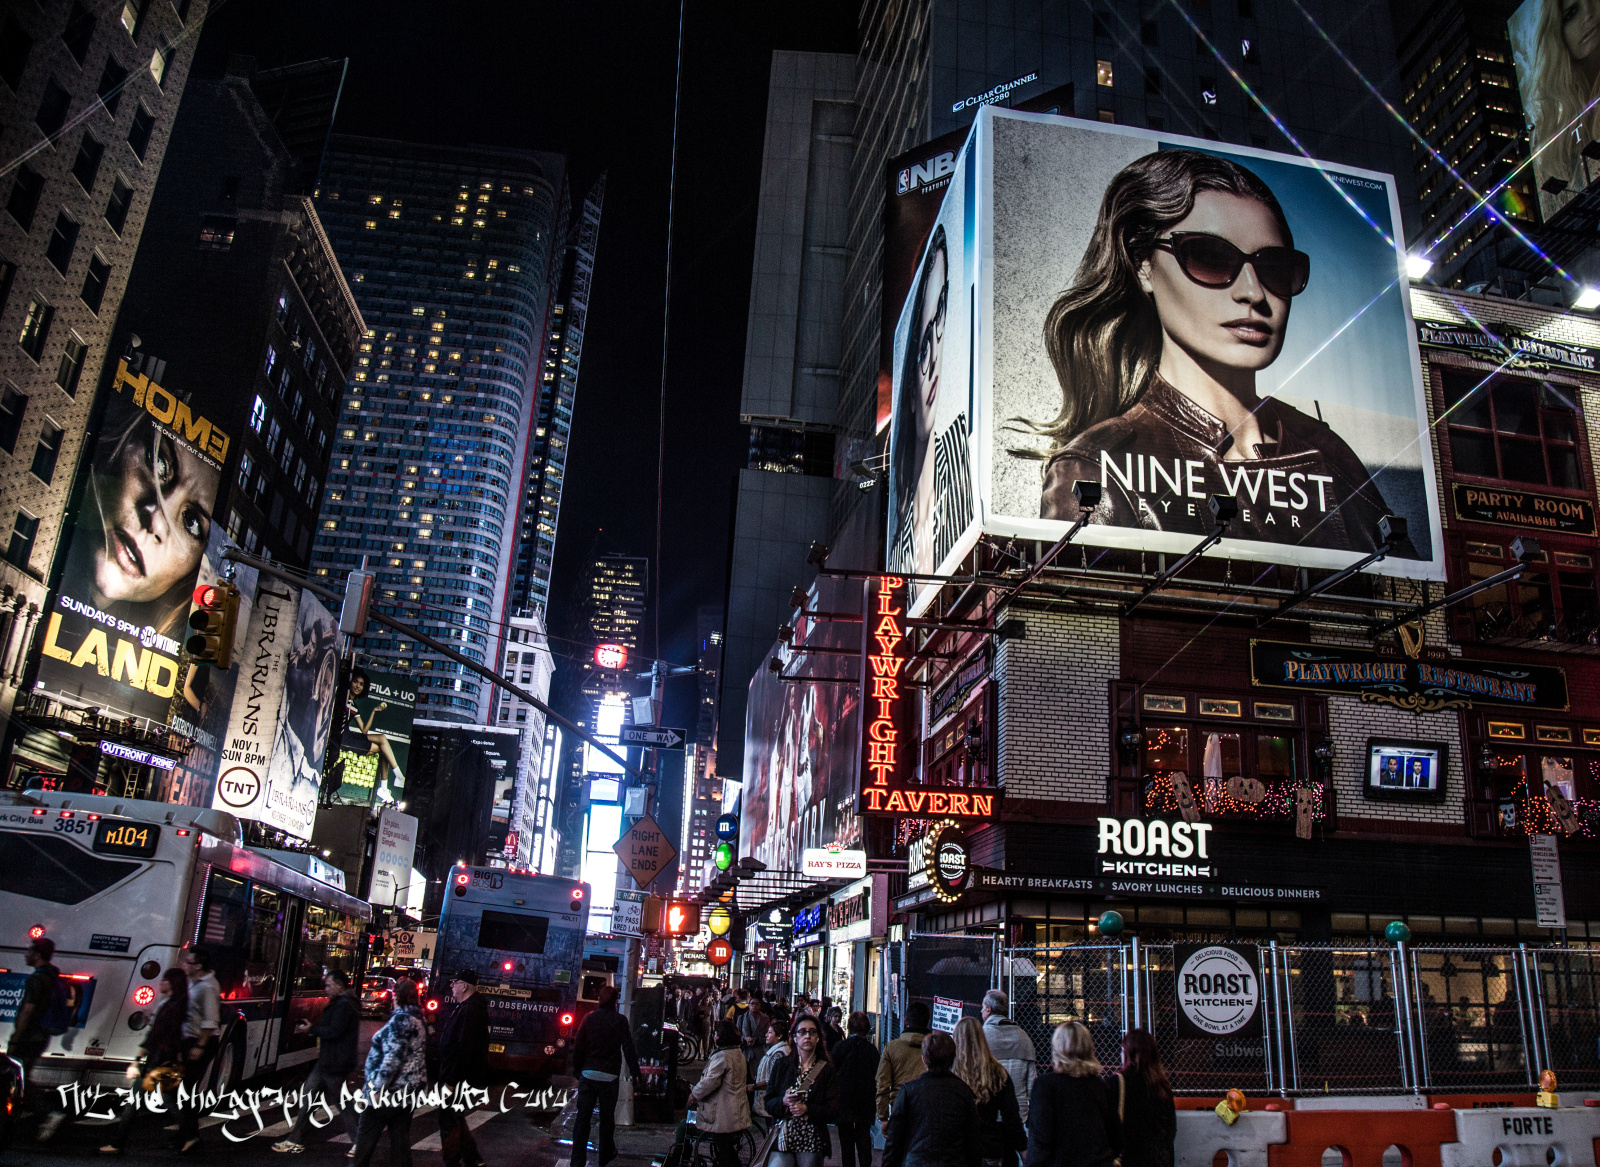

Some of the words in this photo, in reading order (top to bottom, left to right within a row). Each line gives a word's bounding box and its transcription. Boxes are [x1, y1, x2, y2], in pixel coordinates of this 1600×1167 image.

[1327, 174, 1383, 191] NINEWEST.COM
[1511, 336, 1595, 369] RESTAURANT
[152, 421, 162, 432] THE
[162, 428, 177, 441] ONLY
[176, 438, 189, 449] WAY
[187, 445, 198, 456] OUT
[198, 452, 203, 460] IS
[203, 456, 217, 469] BACK
[216, 463, 222, 472] IN
[1101, 450, 1206, 499] NINE
[1218, 464, 1333, 513] WEST
[1138, 499, 1301, 528] EYEEAR
[1466, 490, 1523, 508] PARTY
[1534, 498, 1584, 520] ROOM
[61, 595, 117, 628] SUNDAYS
[117, 619, 140, 638] 9PM
[140, 625, 181, 657] SHOWTIME
[42, 611, 179, 699] LAND
[241, 584, 292, 736] LIBRARIANS
[1379, 644, 1397, 655] Est.
[1427, 650, 1446, 660] 1993
[270, 653, 281, 673] THE
[866, 576, 905, 785] PLAYWRIGHT
[1284, 660, 1408, 684] PLAYWRIGHT
[1418, 662, 1537, 703] RESTAURANT
[369, 682, 391, 697] FILA
[401, 691, 415, 702] UO
[232, 739, 252, 752] NOV
[256, 743, 260, 753] 1
[629, 732, 648, 741] ONE
[657, 734, 676, 743] WAY
[102, 742, 147, 763] OUTFRONT
[150, 756, 175, 770] PRIME
[221, 750, 242, 762] SUN
[244, 753, 266, 766] 8PM
[157, 766, 210, 808] HEART
[225, 781, 255, 795] TNT
[862, 788, 994, 816] TAVERN
[10, 815, 27, 825] City
[28, 816, 44, 825] Bus
[53, 818, 94, 836] 3851
[631, 830, 661, 842] RIGHT
[1097, 818, 1213, 859] ROAST
[631, 844, 659, 857] LANE
[908, 834, 929, 875] ROAS
[631, 859, 657, 871] ENDS
[1116, 861, 1197, 877] KITCHEN
[474, 870, 490, 881] BIG
[471, 879, 490, 890] BUS
[982, 875, 1025, 887] HEARTY
[1028, 877, 1093, 890] BREAKFASTS
[1112, 881, 1153, 893] SAVORY
[1155, 883, 1203, 895] LUNCHES
[1221, 886, 1275, 898] DELICIOUS
[1277, 888, 1321, 899] DINNERS
[844, 894, 863, 927] PIZZA
[625, 916, 639, 925] PASS
[716, 947, 727, 958] m
[1194, 949, 1223, 962] DELICIOUS
[1224, 951, 1239, 962] FOOD
[477, 985, 517, 997] ENVIRO
[1183, 973, 1253, 996] ROAST
[444, 995, 459, 1004] ON
[498, 1001, 560, 1014] OBSERVATORY
[1193, 998, 1245, 1007] KITCHEN
[500, 1010, 522, 1020] OPEN
[1192, 1015, 1203, 1026] ONE
[1204, 1022, 1221, 1031] BOWL
[1234, 1014, 1246, 1026] TIME
[1502, 1116, 1553, 1136] FORTE
